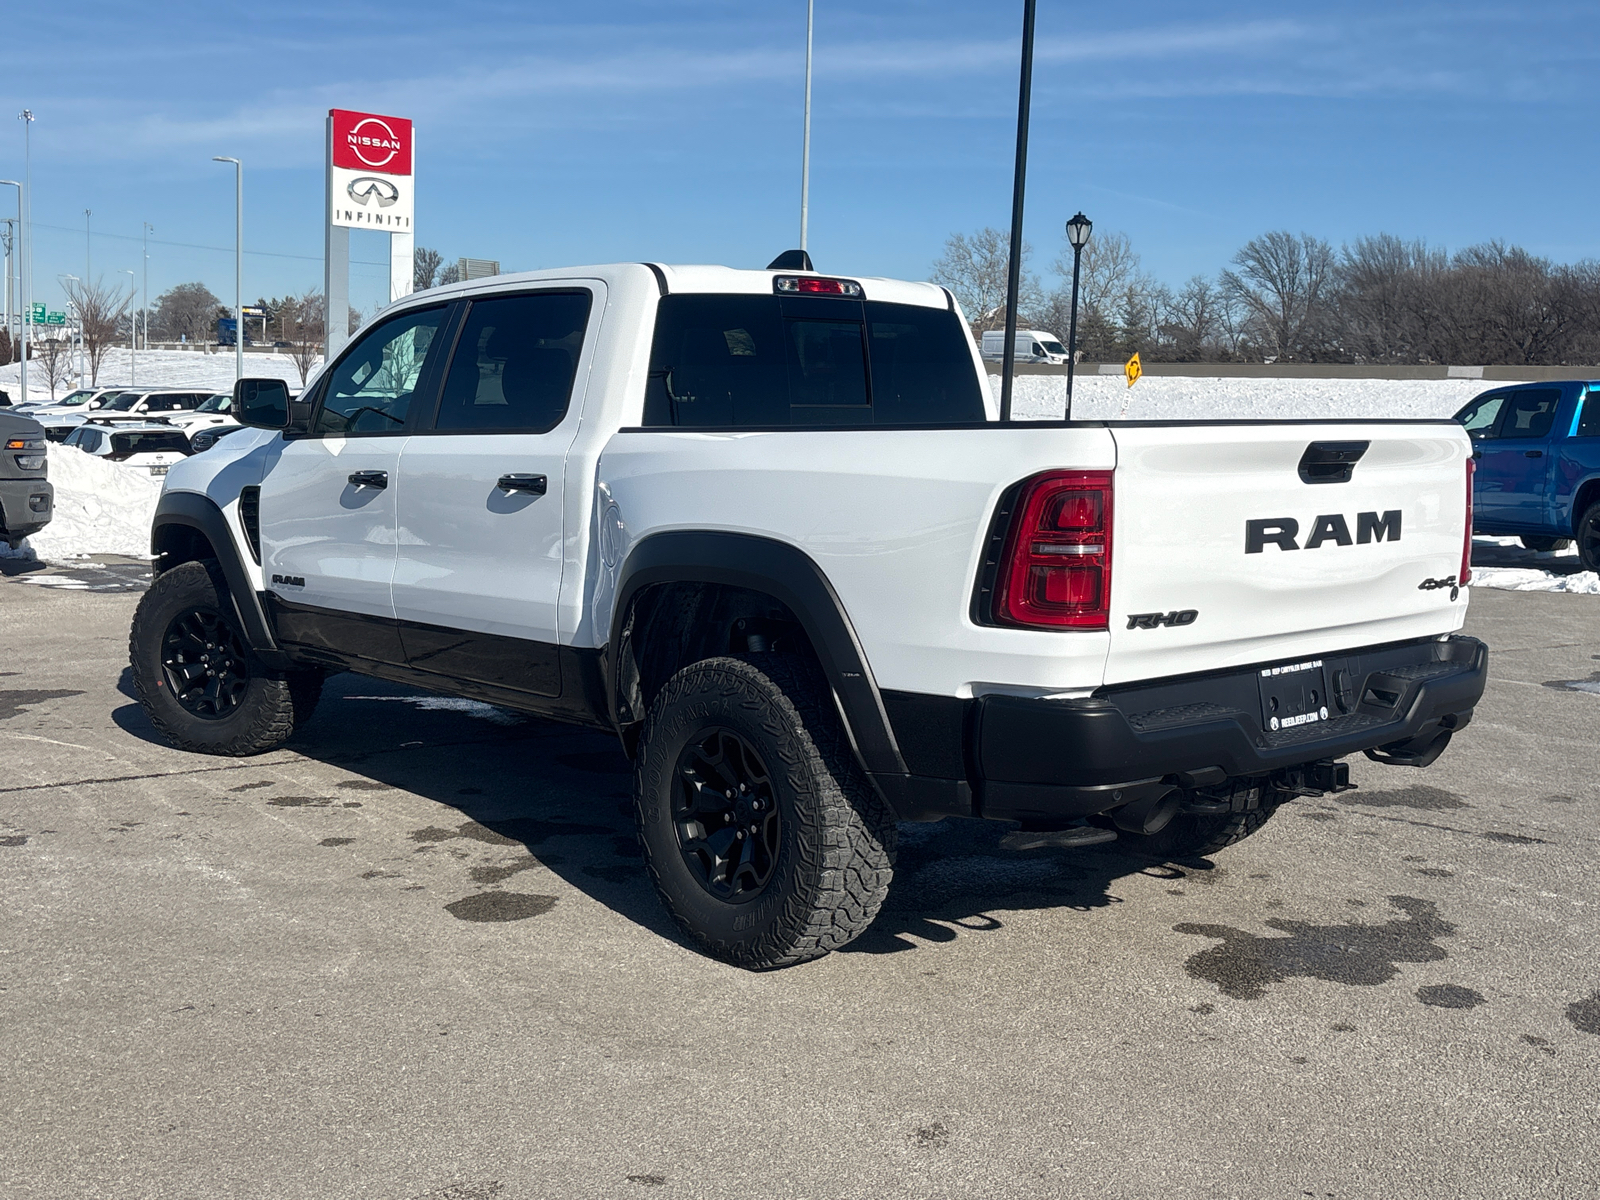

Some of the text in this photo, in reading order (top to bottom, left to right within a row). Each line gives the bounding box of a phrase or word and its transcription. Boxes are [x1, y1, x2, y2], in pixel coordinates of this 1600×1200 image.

[347, 134, 401, 150] NISSAN
[336, 209, 410, 228] INFINITI
[1244, 509, 1403, 554] RAM
[271, 573, 306, 587] RAM
[1126, 609, 1199, 630] RHO
[1281, 664, 1300, 673] CHRYSLER
[1300, 662, 1313, 670] DODGE
[1280, 711, 1319, 728] REEDJEEP.COM
